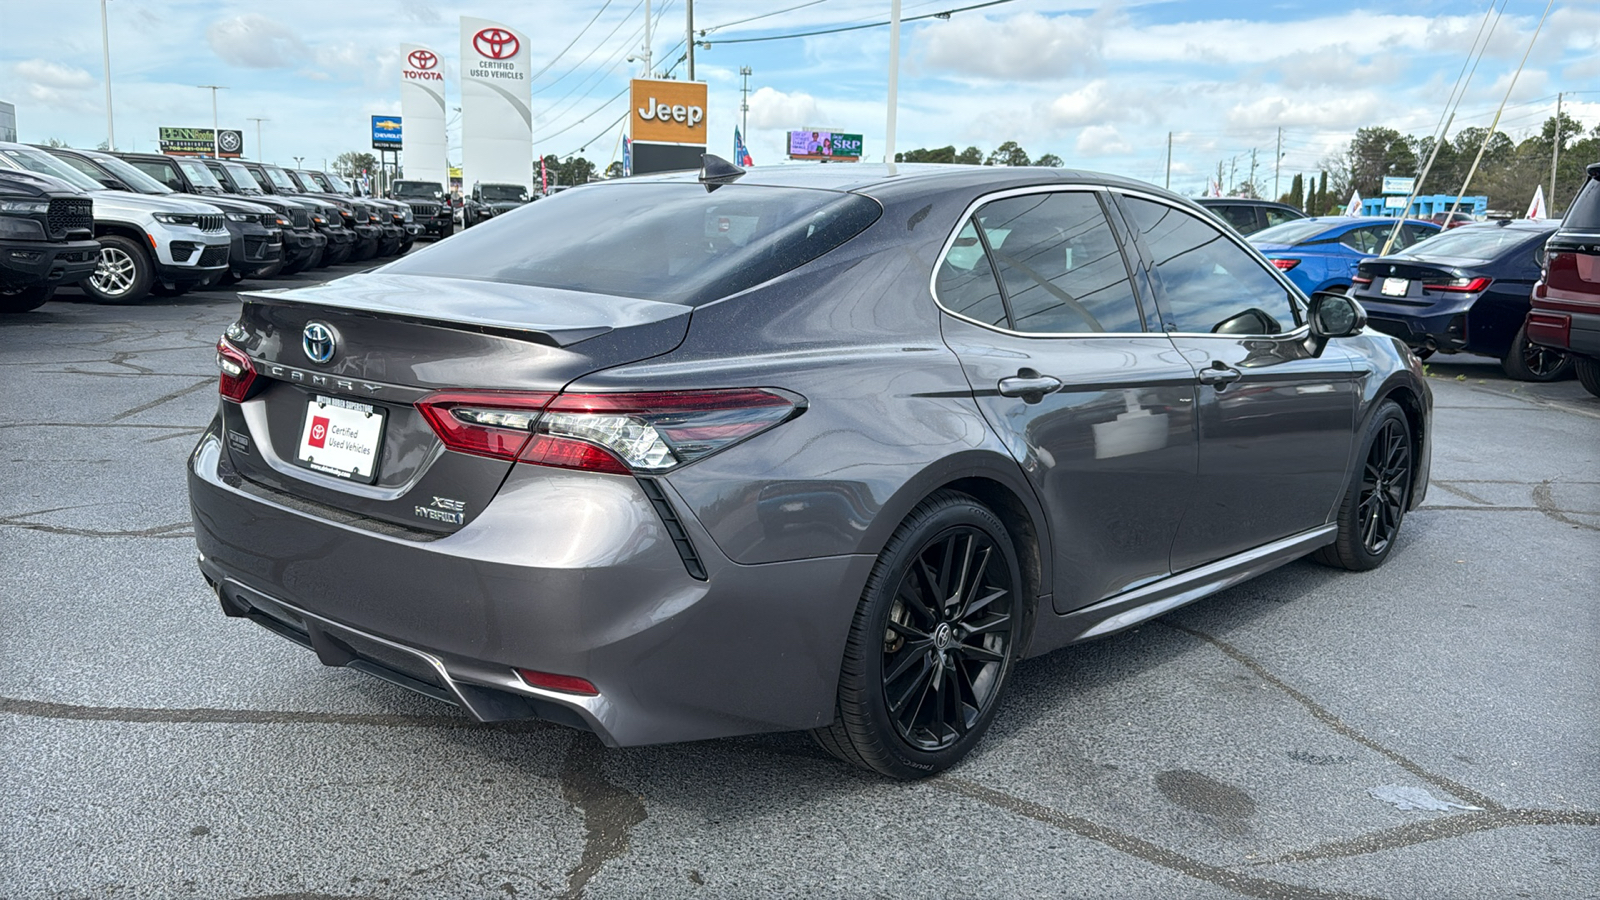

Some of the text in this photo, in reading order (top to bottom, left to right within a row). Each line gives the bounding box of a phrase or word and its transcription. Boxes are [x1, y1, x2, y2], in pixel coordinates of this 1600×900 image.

[479, 60, 515, 70] CERTIFIED
[402, 70, 444, 81] TOYOTA
[470, 69, 524, 80] USED VEHICLES
[638, 97, 703, 127] Jeep
[161, 127, 214, 140] PENN Roofin
[833, 139, 861, 150] SRP
[272, 366, 382, 393] CAMRY
[331, 425, 359, 439] Certified
[328, 437, 371, 455] Used Vehicles
[430, 496, 466, 511] XSE
[415, 505, 457, 523] HYBRID
